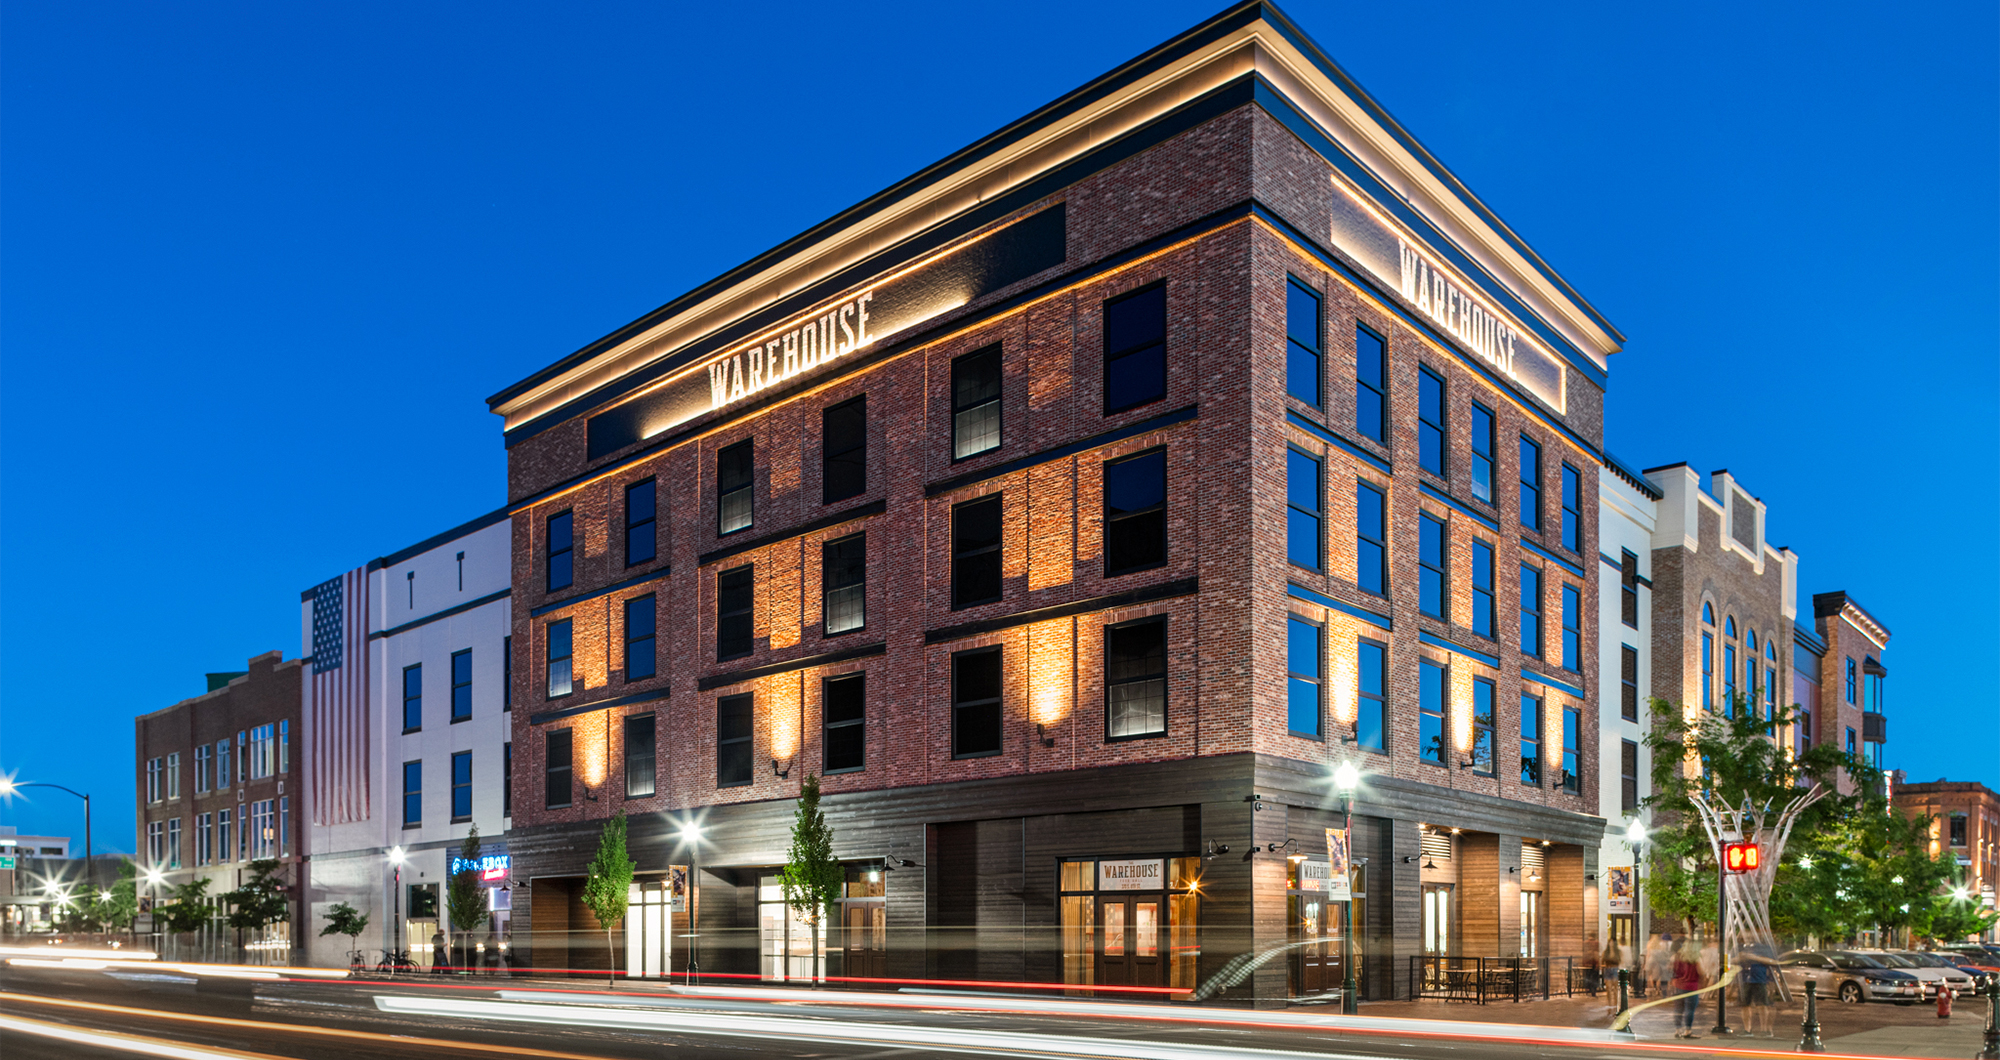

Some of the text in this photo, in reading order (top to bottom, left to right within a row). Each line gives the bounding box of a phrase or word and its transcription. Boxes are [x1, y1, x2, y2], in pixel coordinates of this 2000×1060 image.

[708, 291, 873, 410] WAREHOUSE
[1398, 237, 1517, 381] WAREHOUSE
[1104, 863, 1159, 879] WAREHOUSE
